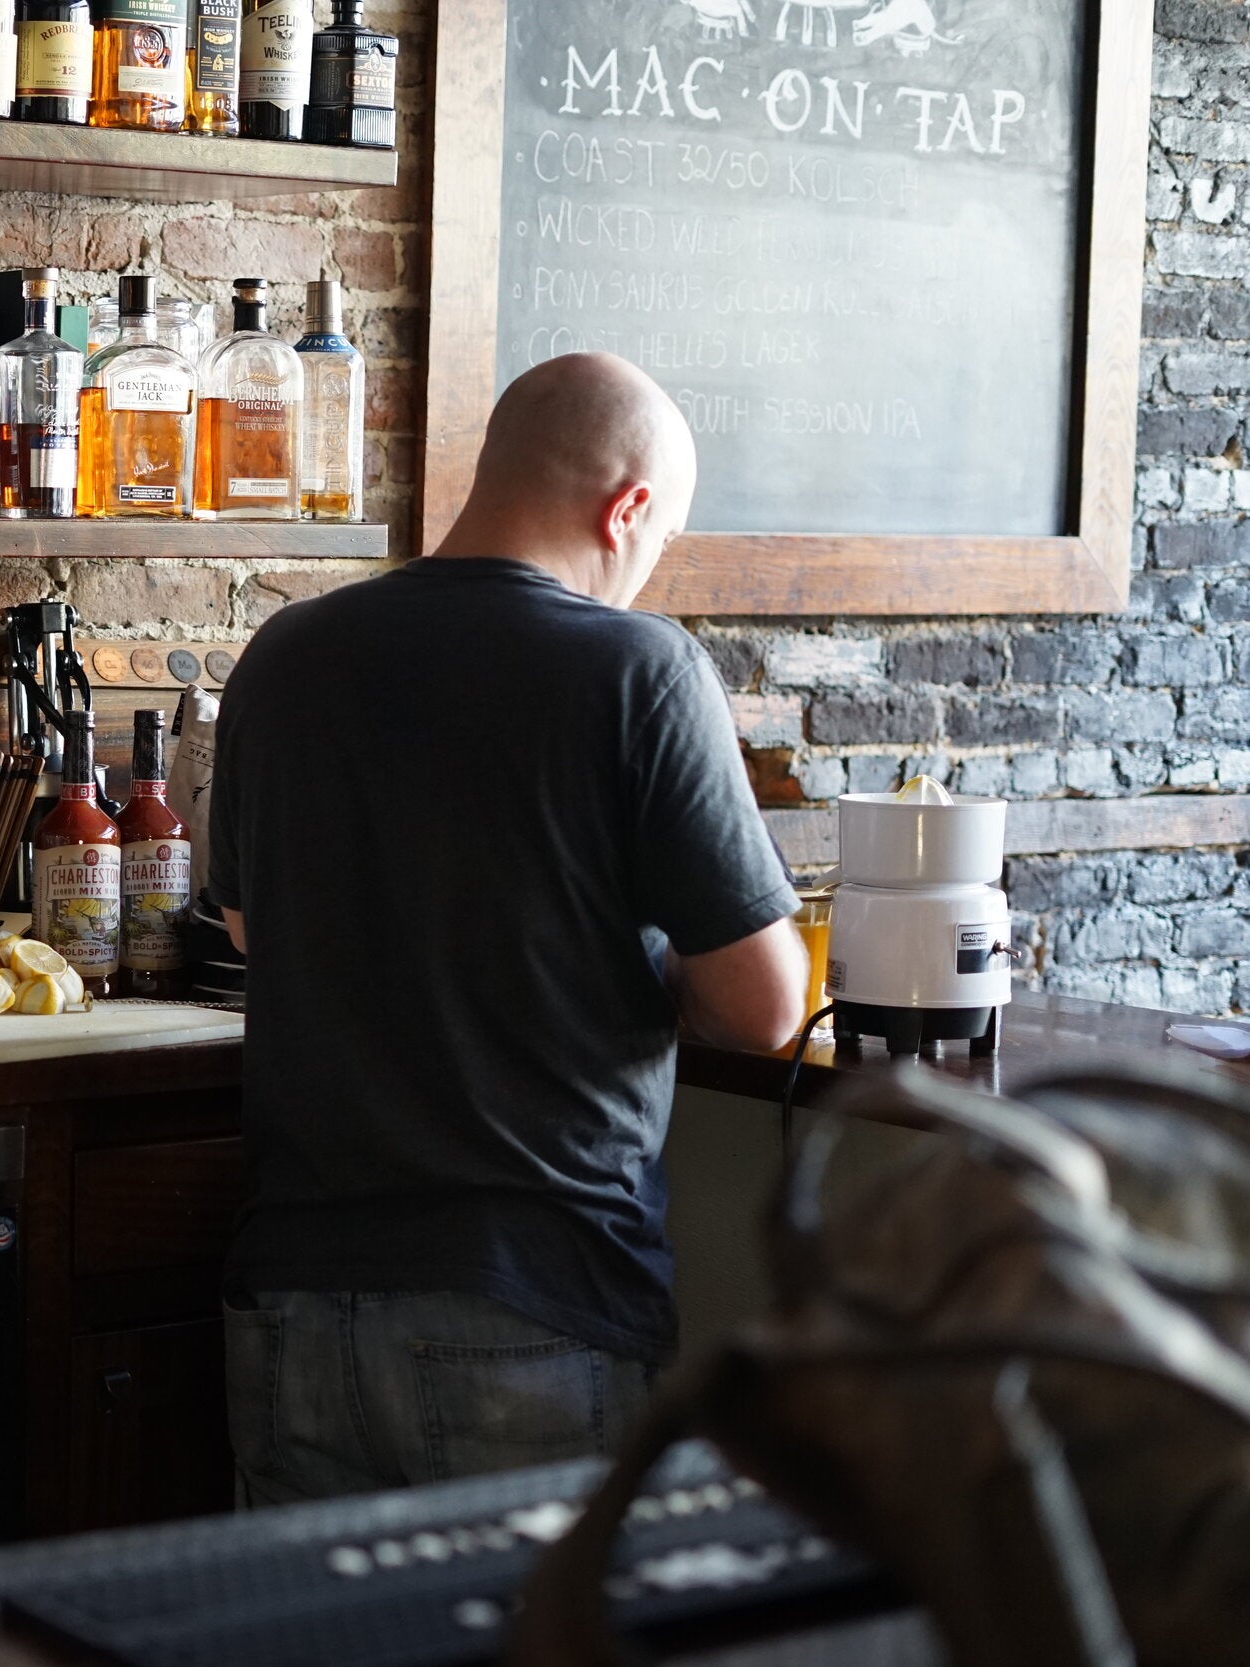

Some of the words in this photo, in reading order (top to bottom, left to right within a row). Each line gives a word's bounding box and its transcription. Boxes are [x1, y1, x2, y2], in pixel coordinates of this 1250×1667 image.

[203, 6, 235, 17] BUSH
[61, 65, 77, 75] 12
[559, 44, 725, 122] MAC
[759, 69, 869, 140] ON
[896, 86, 1026, 155] TAP
[533, 129, 665, 187] COAST
[677, 142, 771, 190] 32/50
[537, 196, 656, 252] WICKED
[300, 338, 349, 348] TINCU
[742, 330, 822, 369] LAGER
[117, 382, 183, 392] GENTLEMAN
[138, 392, 163, 401] JACK
[228, 386, 295, 406] BERNHEIM
[238, 400, 282, 411] ORIGINAL
[762, 397, 875, 438] SESSION
[882, 400, 924, 441] IPA
[231, 482, 237, 494] 7
[78, 887, 102, 896] MIX
[152, 882, 175, 890] MIX
